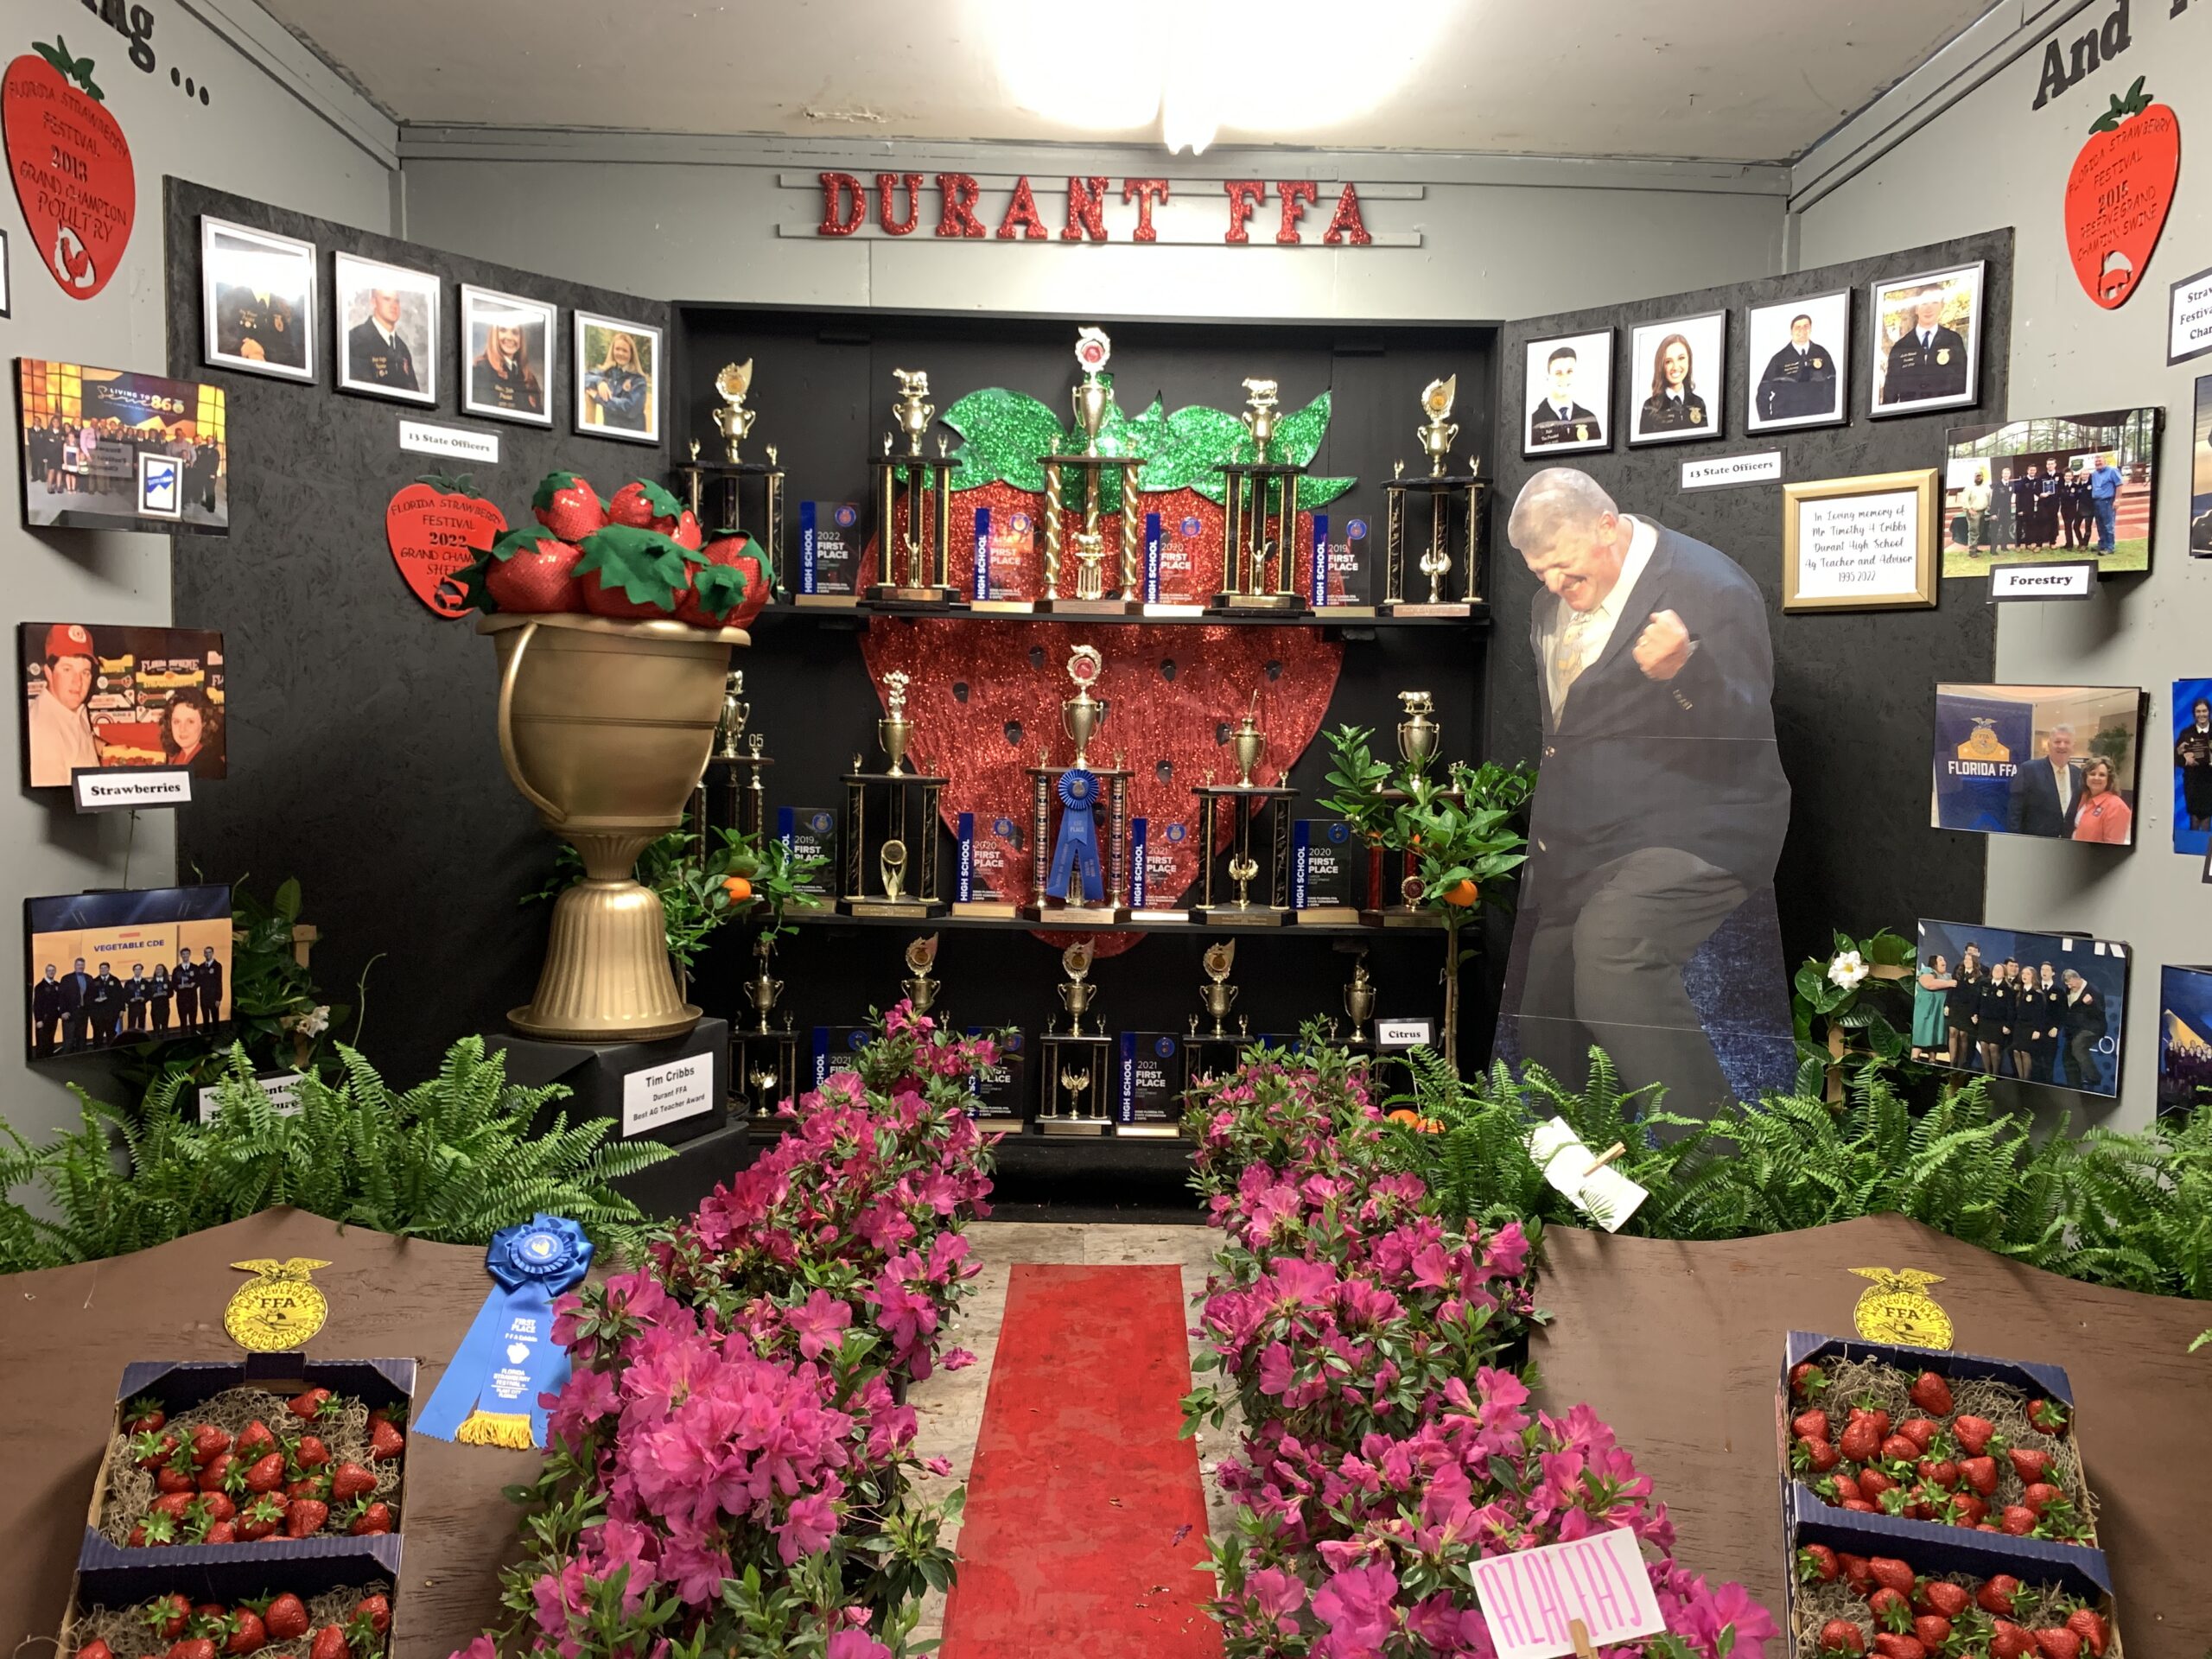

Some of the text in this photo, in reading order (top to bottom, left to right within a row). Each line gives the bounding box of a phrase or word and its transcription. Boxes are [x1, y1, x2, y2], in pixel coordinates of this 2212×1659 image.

[2032, 0, 2132, 111] And
[43, 111, 100, 157] FESTIVAL
[2109, 118, 2171, 152] STRAWBERRY
[2094, 148, 2143, 189] FESTIVAL
[20, 160, 127, 226] GRAND CHAMPION
[2098, 180, 2129, 213] 2015
[38, 191, 112, 242] POULTRY
[818, 172, 1372, 246] DURANT FFA
[2123, 203, 2158, 235] SWINE
[110, 387, 137, 397] LIVING
[423, 434, 448, 446] State
[451, 438, 490, 453] Officers
[1689, 461, 1773, 479] 13 State Officers
[391, 499, 500, 524] FLORIDA STRAWBERRY
[1815, 512, 1822, 521] In
[1858, 509, 1892, 518] memory
[1896, 504, 1905, 516] of
[423, 515, 476, 530] FESTIVAL
[1830, 524, 1865, 537] Timothy
[1879, 520, 1906, 532] Cribbs
[429, 532, 467, 548] 2022
[817, 542, 844, 550] FIRST
[1814, 541, 1845, 553] Durant
[1873, 537, 1904, 549] School
[400, 547, 440, 561] GRAND
[804, 528, 813, 593] HIGH SCHOOL
[817, 550, 849, 559] PLACE
[990, 548, 1017, 556] FIRST
[990, 556, 1021, 565] PLACE
[977, 535, 987, 600] HIGH SCHOOL
[1160, 561, 1192, 569] PLACE
[1327, 563, 1358, 571] PLACE
[1805, 554, 1912, 570] Ag Teacher and Advisor
[1148, 540, 1158, 604] HIGH SCHOOL
[1316, 541, 1325, 606] HIGH SCHOOL
[2010, 575, 2073, 586] Forestry
[748, 734, 764, 747] 05
[1948, 760, 2018, 777] FLORIDA FFA
[91, 783, 181, 796] Strawberries
[794, 836, 815, 844] 2019
[960, 839, 969, 901] HIGH SCHOOL
[974, 859, 1004, 868] PLACE
[1147, 864, 1177, 873] PLACE
[1134, 844, 1143, 906] HIGH SCHOOL
[1296, 846, 1306, 908] HIGH SCHOOL
[93, 941, 144, 952] VEGETABLE
[831, 1056, 851, 1065] 2021
[645, 1066, 695, 1088] Tim Cribbs
[652, 1085, 688, 1102] Durant FFA
[1122, 1058, 1132, 1121] HIGH SCHOOL
[633, 1093, 705, 1122] Best AG Teacher Award
[260, 1298, 296, 1308] FFA
[1872, 1298, 1936, 1323] AGRICULTURAL
[1885, 1306, 1921, 1320] FFA
[246, 1325, 303, 1340] EDUCATION
[511, 1324, 536, 1333] PLACE
[1478, 1536, 1642, 1649] AZALEAS
